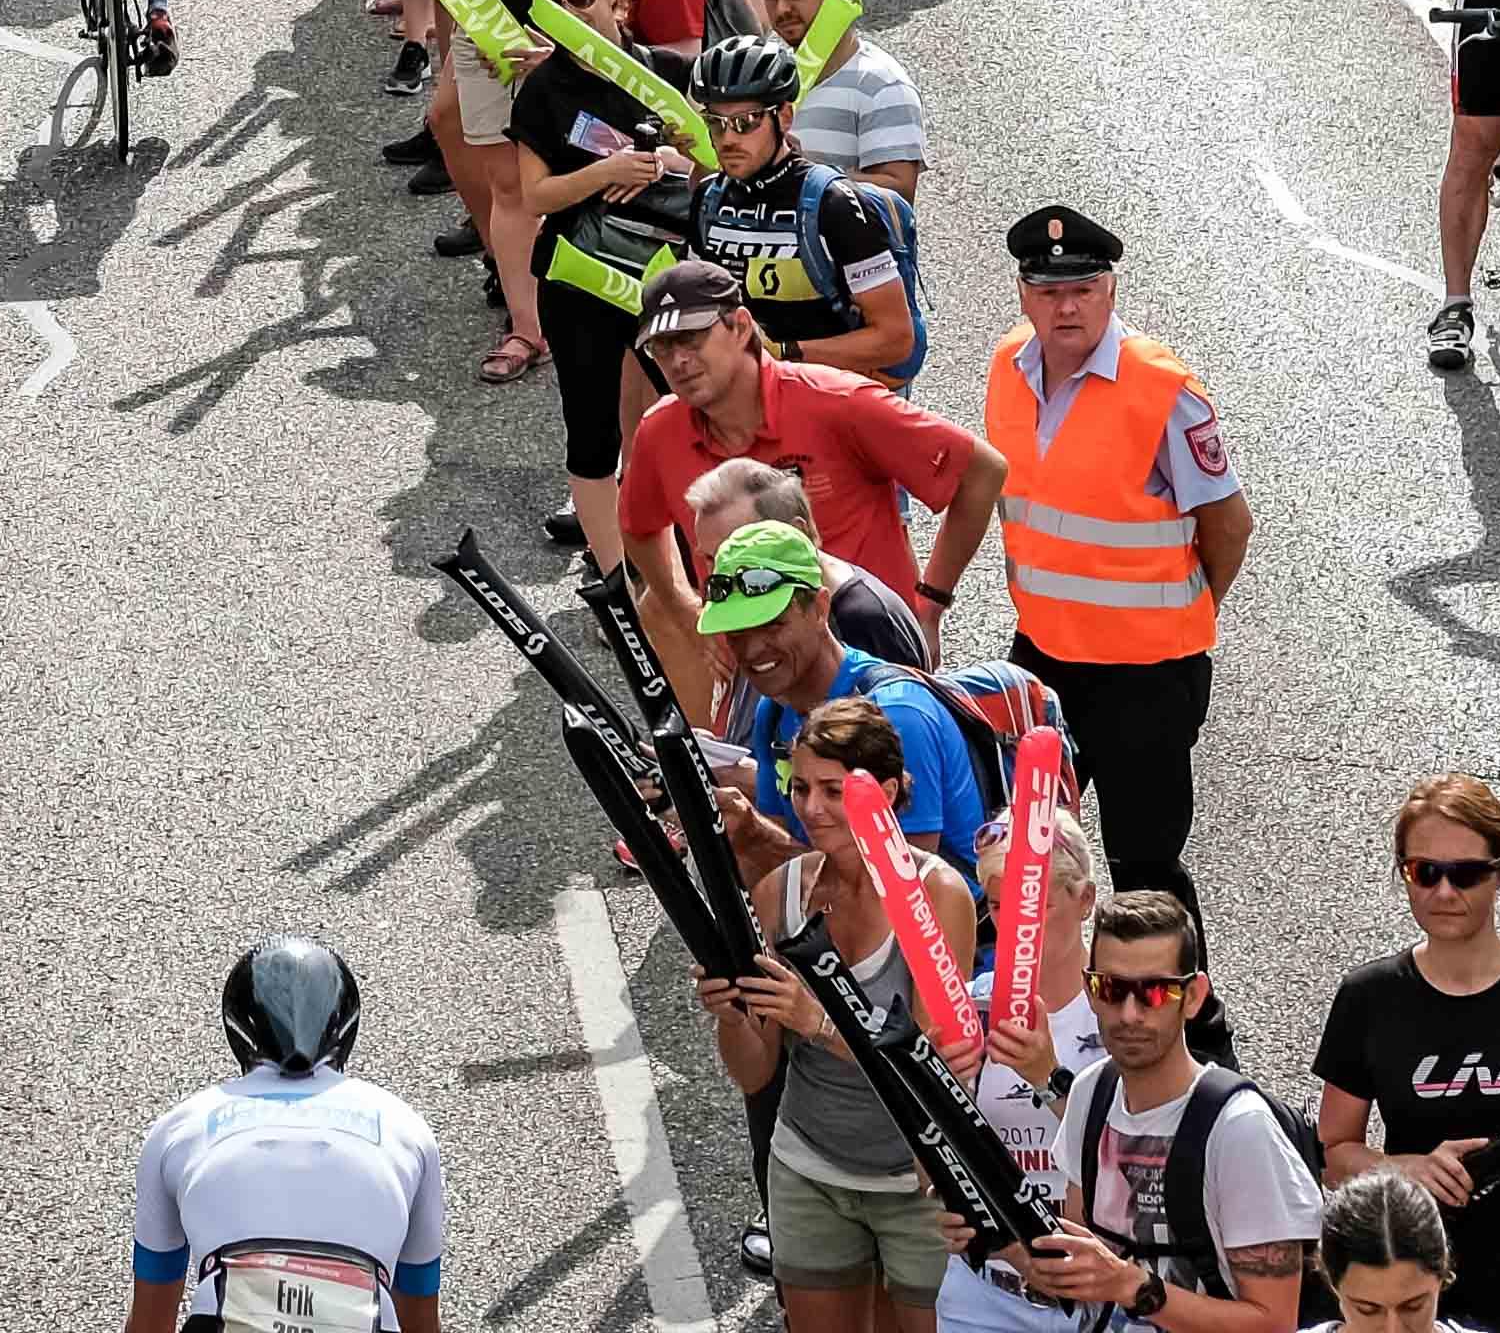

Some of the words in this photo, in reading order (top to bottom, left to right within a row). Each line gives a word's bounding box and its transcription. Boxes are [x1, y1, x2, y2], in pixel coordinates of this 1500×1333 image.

[459, 567, 532, 636] SCOTT
[608, 605, 656, 678] SCOTT
[577, 703, 648, 773] SCOTT
[1021, 865, 1044, 912] new
[906, 886, 938, 927] new
[927, 930, 979, 1040] balance
[1009, 916, 1041, 1031] balance
[928, 1056, 988, 1127] SCOTT
[1002, 1126, 1046, 1147] 2017
[938, 1145, 1000, 1231] SCOTT
[277, 1279, 314, 1317] Erik
